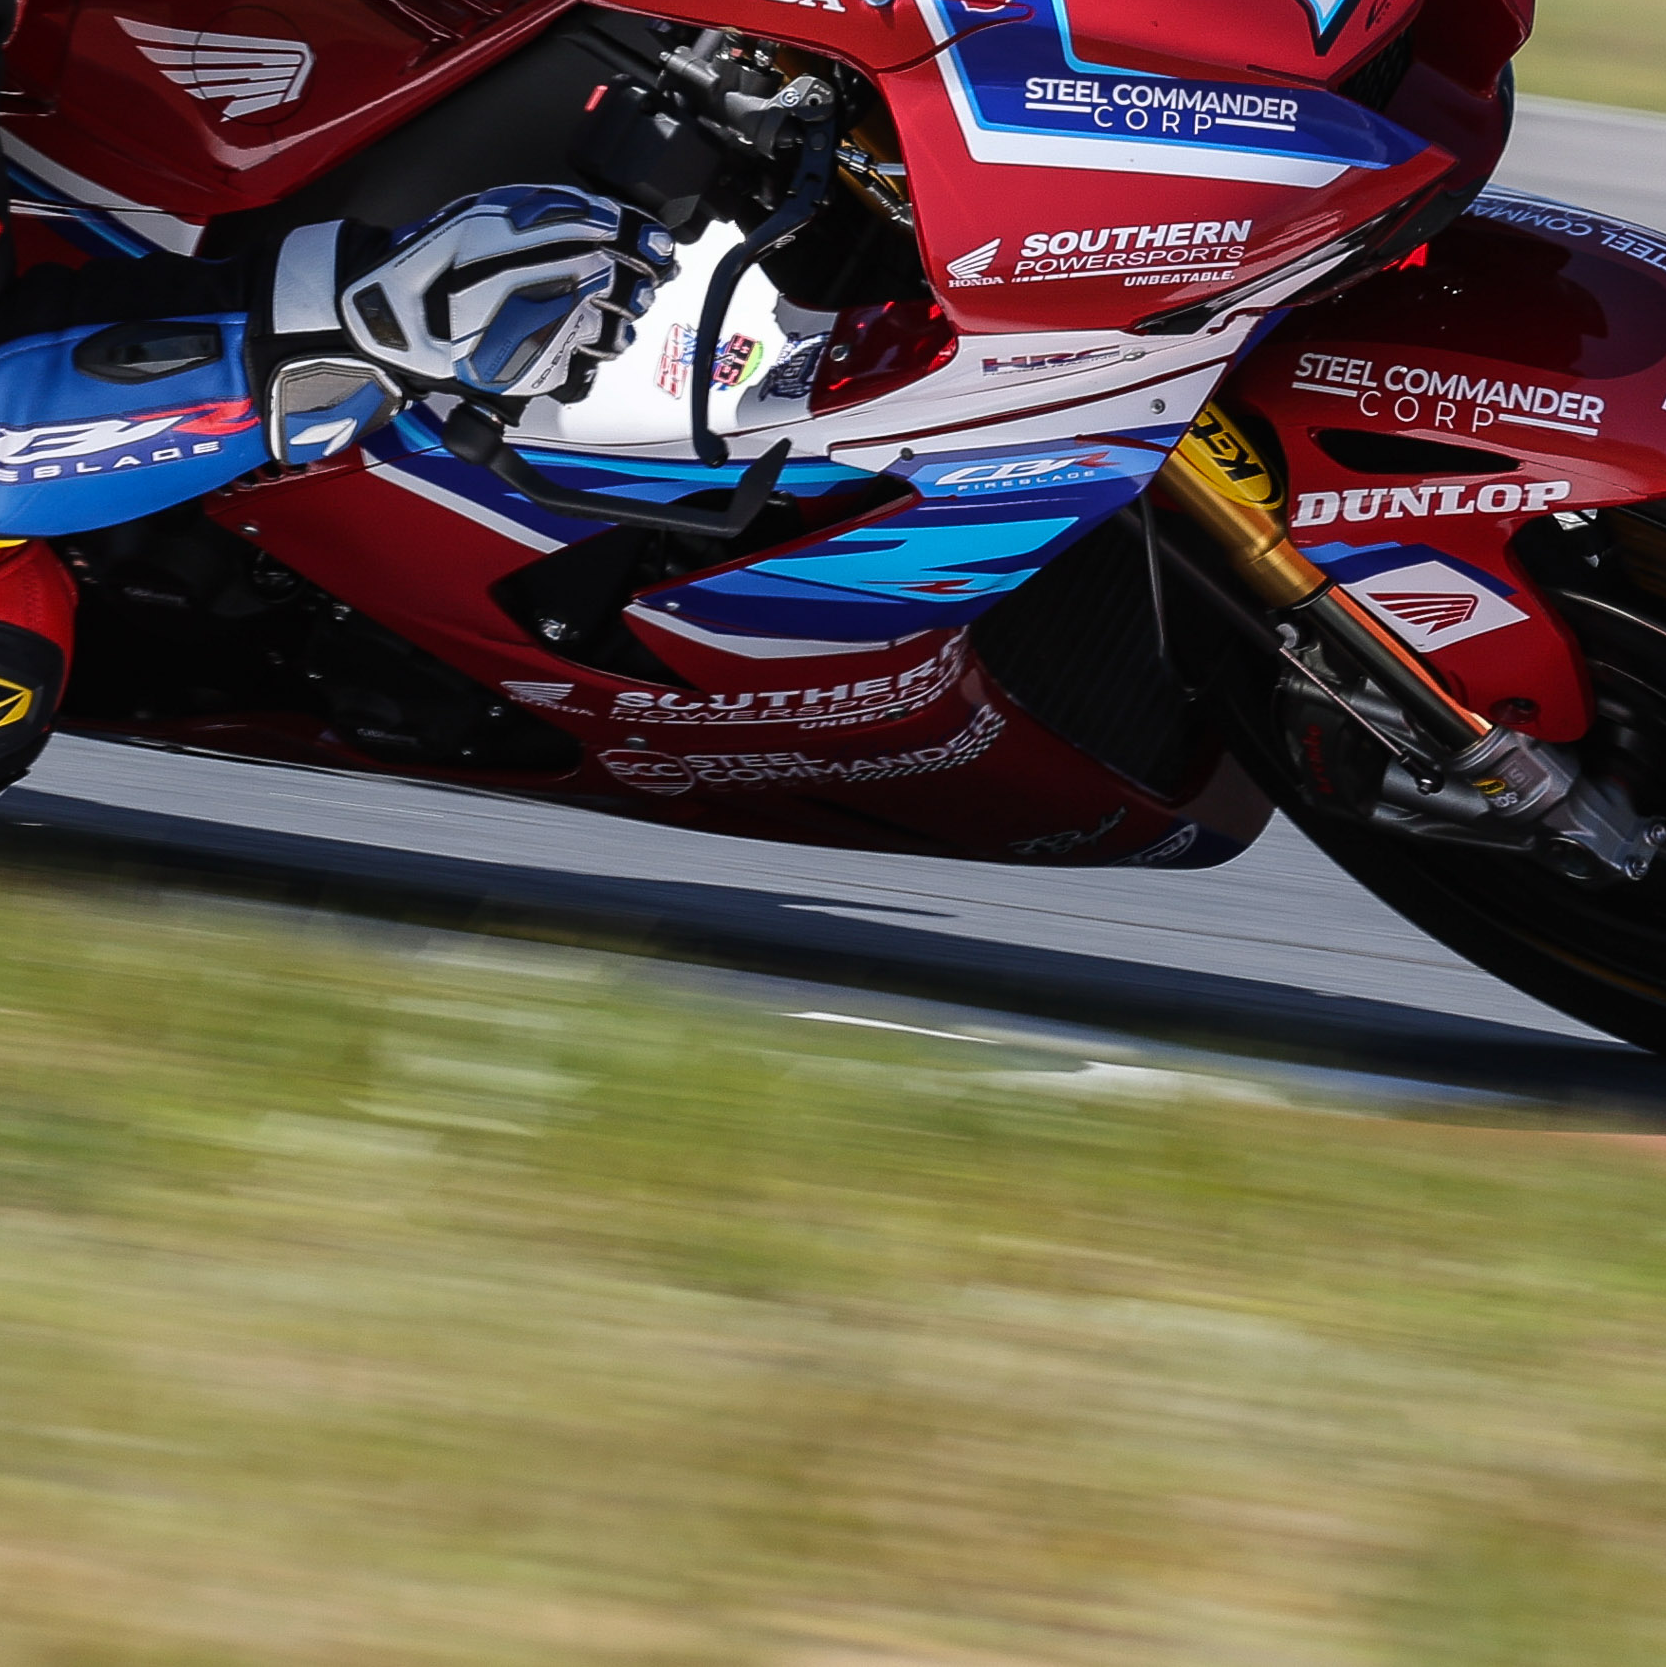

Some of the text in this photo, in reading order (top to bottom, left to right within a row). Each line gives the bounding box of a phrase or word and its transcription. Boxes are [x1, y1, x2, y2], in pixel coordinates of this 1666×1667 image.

[1025, 78, 1298, 124] STEEL COMMANDER
[1093, 107, 1213, 136] CORP
[1020, 219, 1253, 257] SOUTHERN
[1014, 245, 1246, 275] POWERSPORTS
[948, 276, 1005, 288] HONDA
[1295, 352, 1605, 424] STEEL COMMANDER
[1359, 391, 1496, 432] CORP
[957, 470, 1096, 492] FIREBLADE
[1292, 479, 1571, 529] DUNLOP
[683, 751, 825, 769] STEEL
